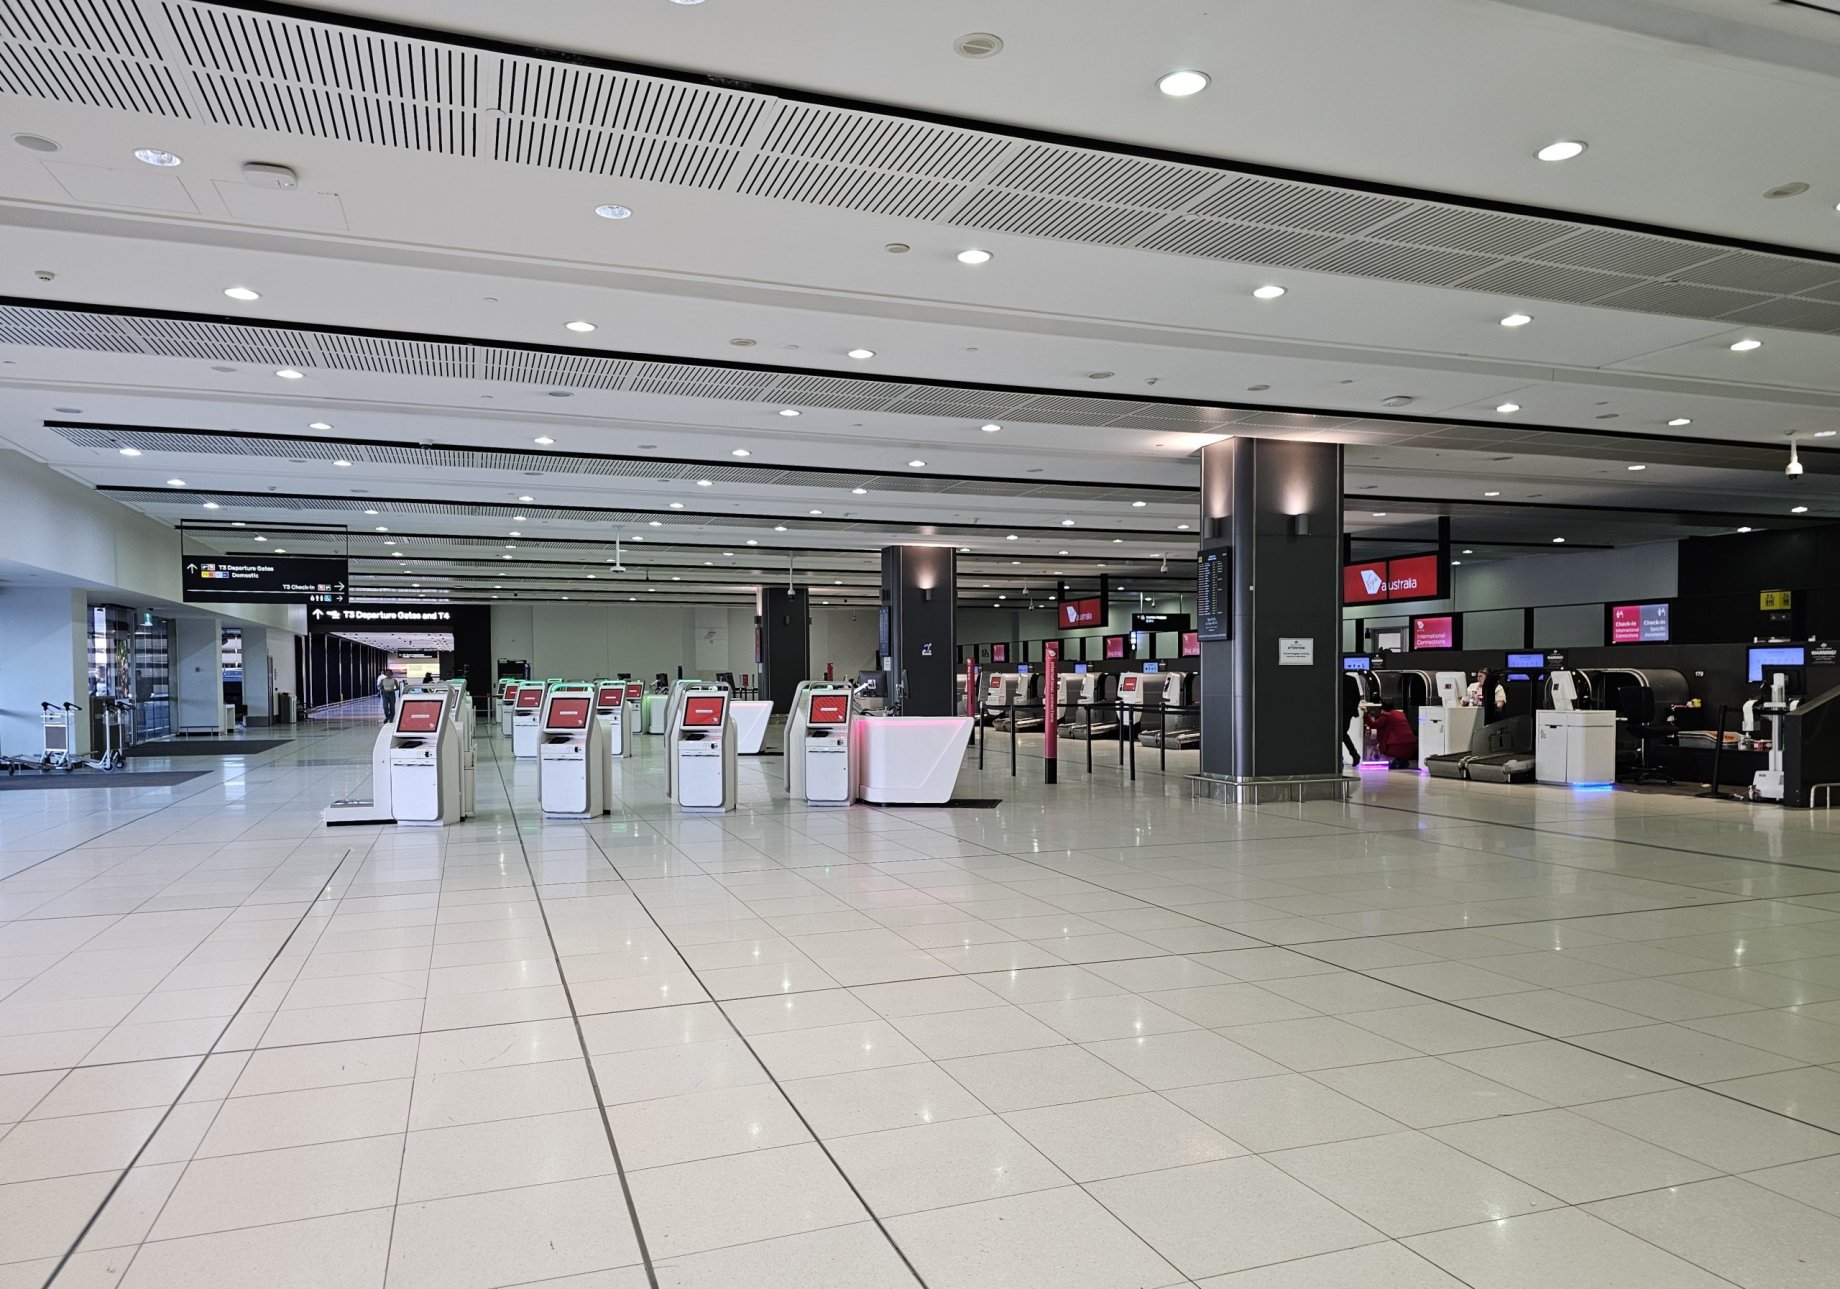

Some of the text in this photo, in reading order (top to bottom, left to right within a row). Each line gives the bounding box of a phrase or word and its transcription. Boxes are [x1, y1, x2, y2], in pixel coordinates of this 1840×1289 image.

[1381, 579, 1417, 591] australia
[343, 610, 450, 620] T3 Departure Gates and T4
